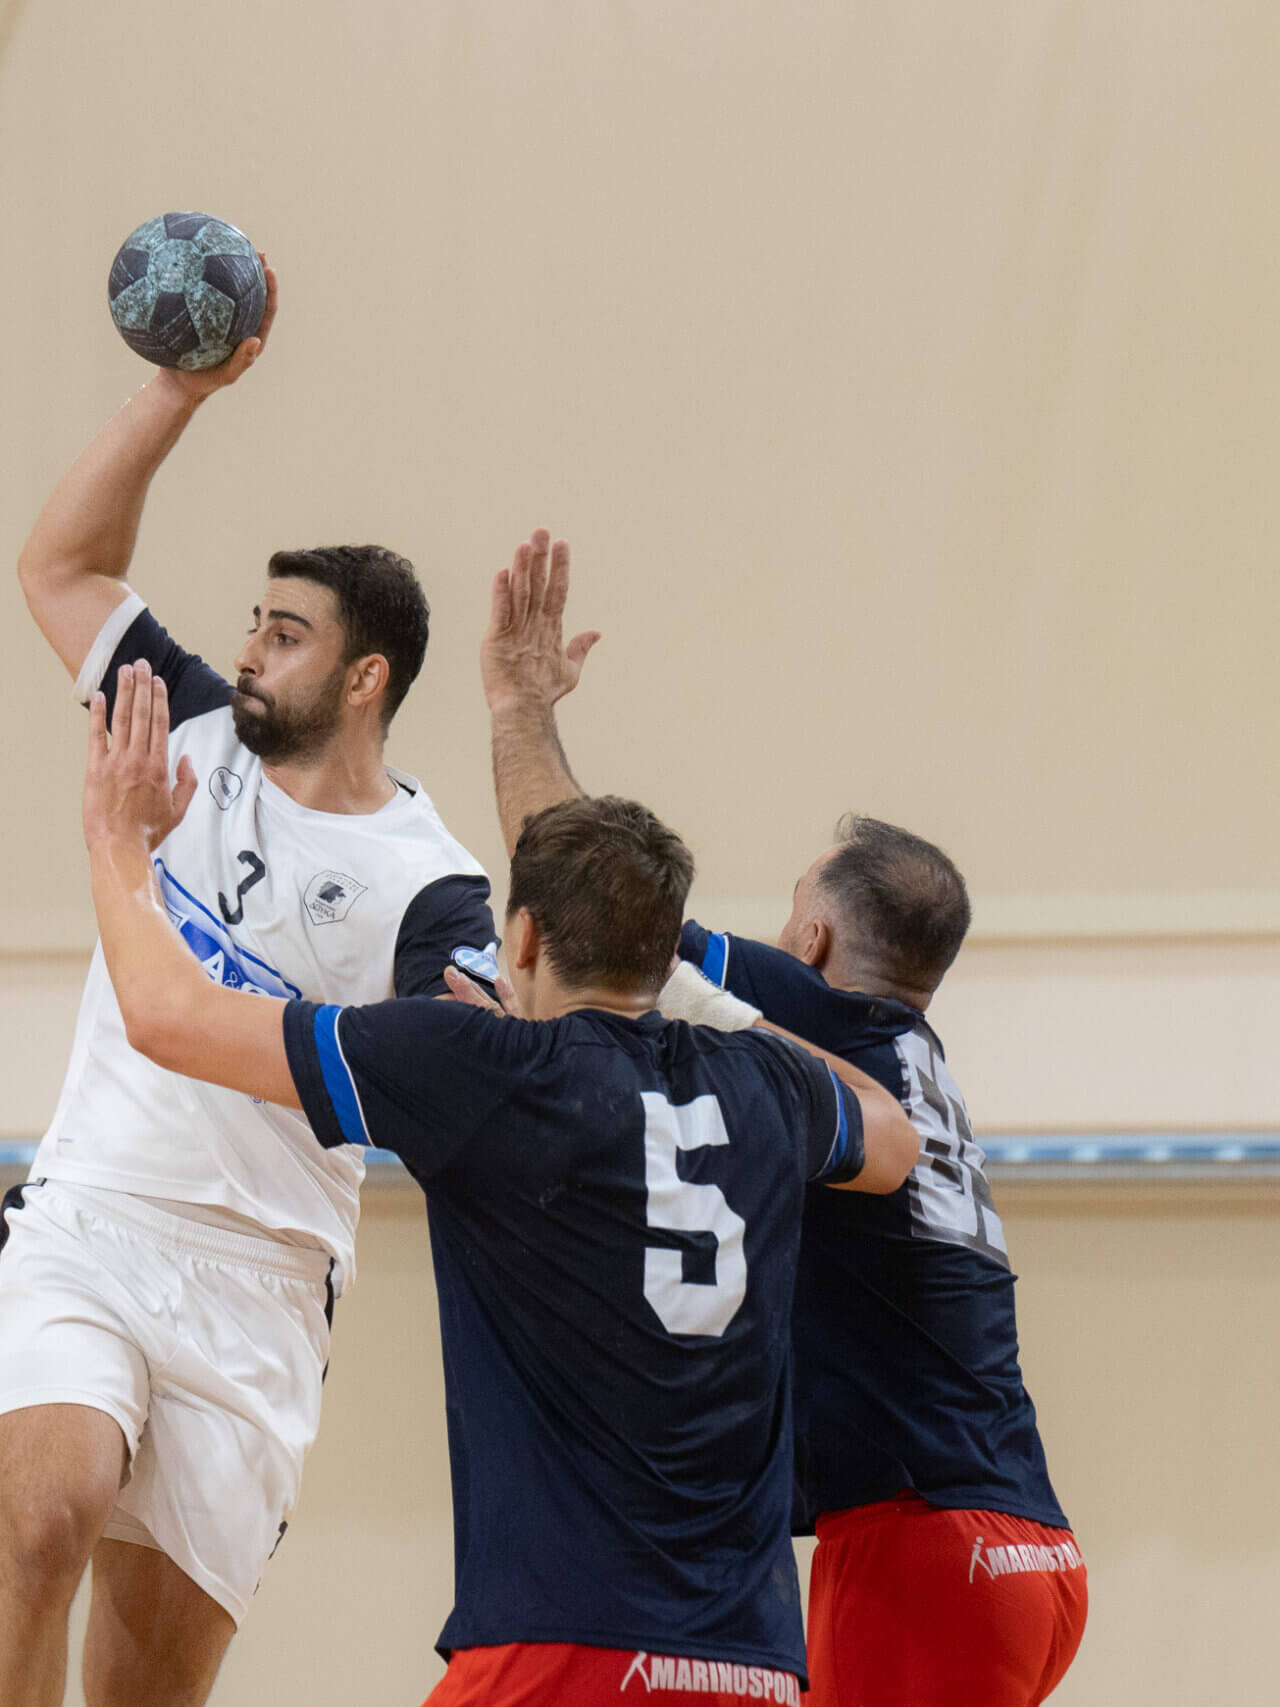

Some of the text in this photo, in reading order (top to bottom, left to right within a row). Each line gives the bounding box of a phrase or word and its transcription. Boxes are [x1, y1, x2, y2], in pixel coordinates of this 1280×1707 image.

[639, 1090, 748, 1338] 5
[985, 1540, 1082, 1577] MARINOSPO
[650, 1655, 801, 1707] MARINOSPOR
